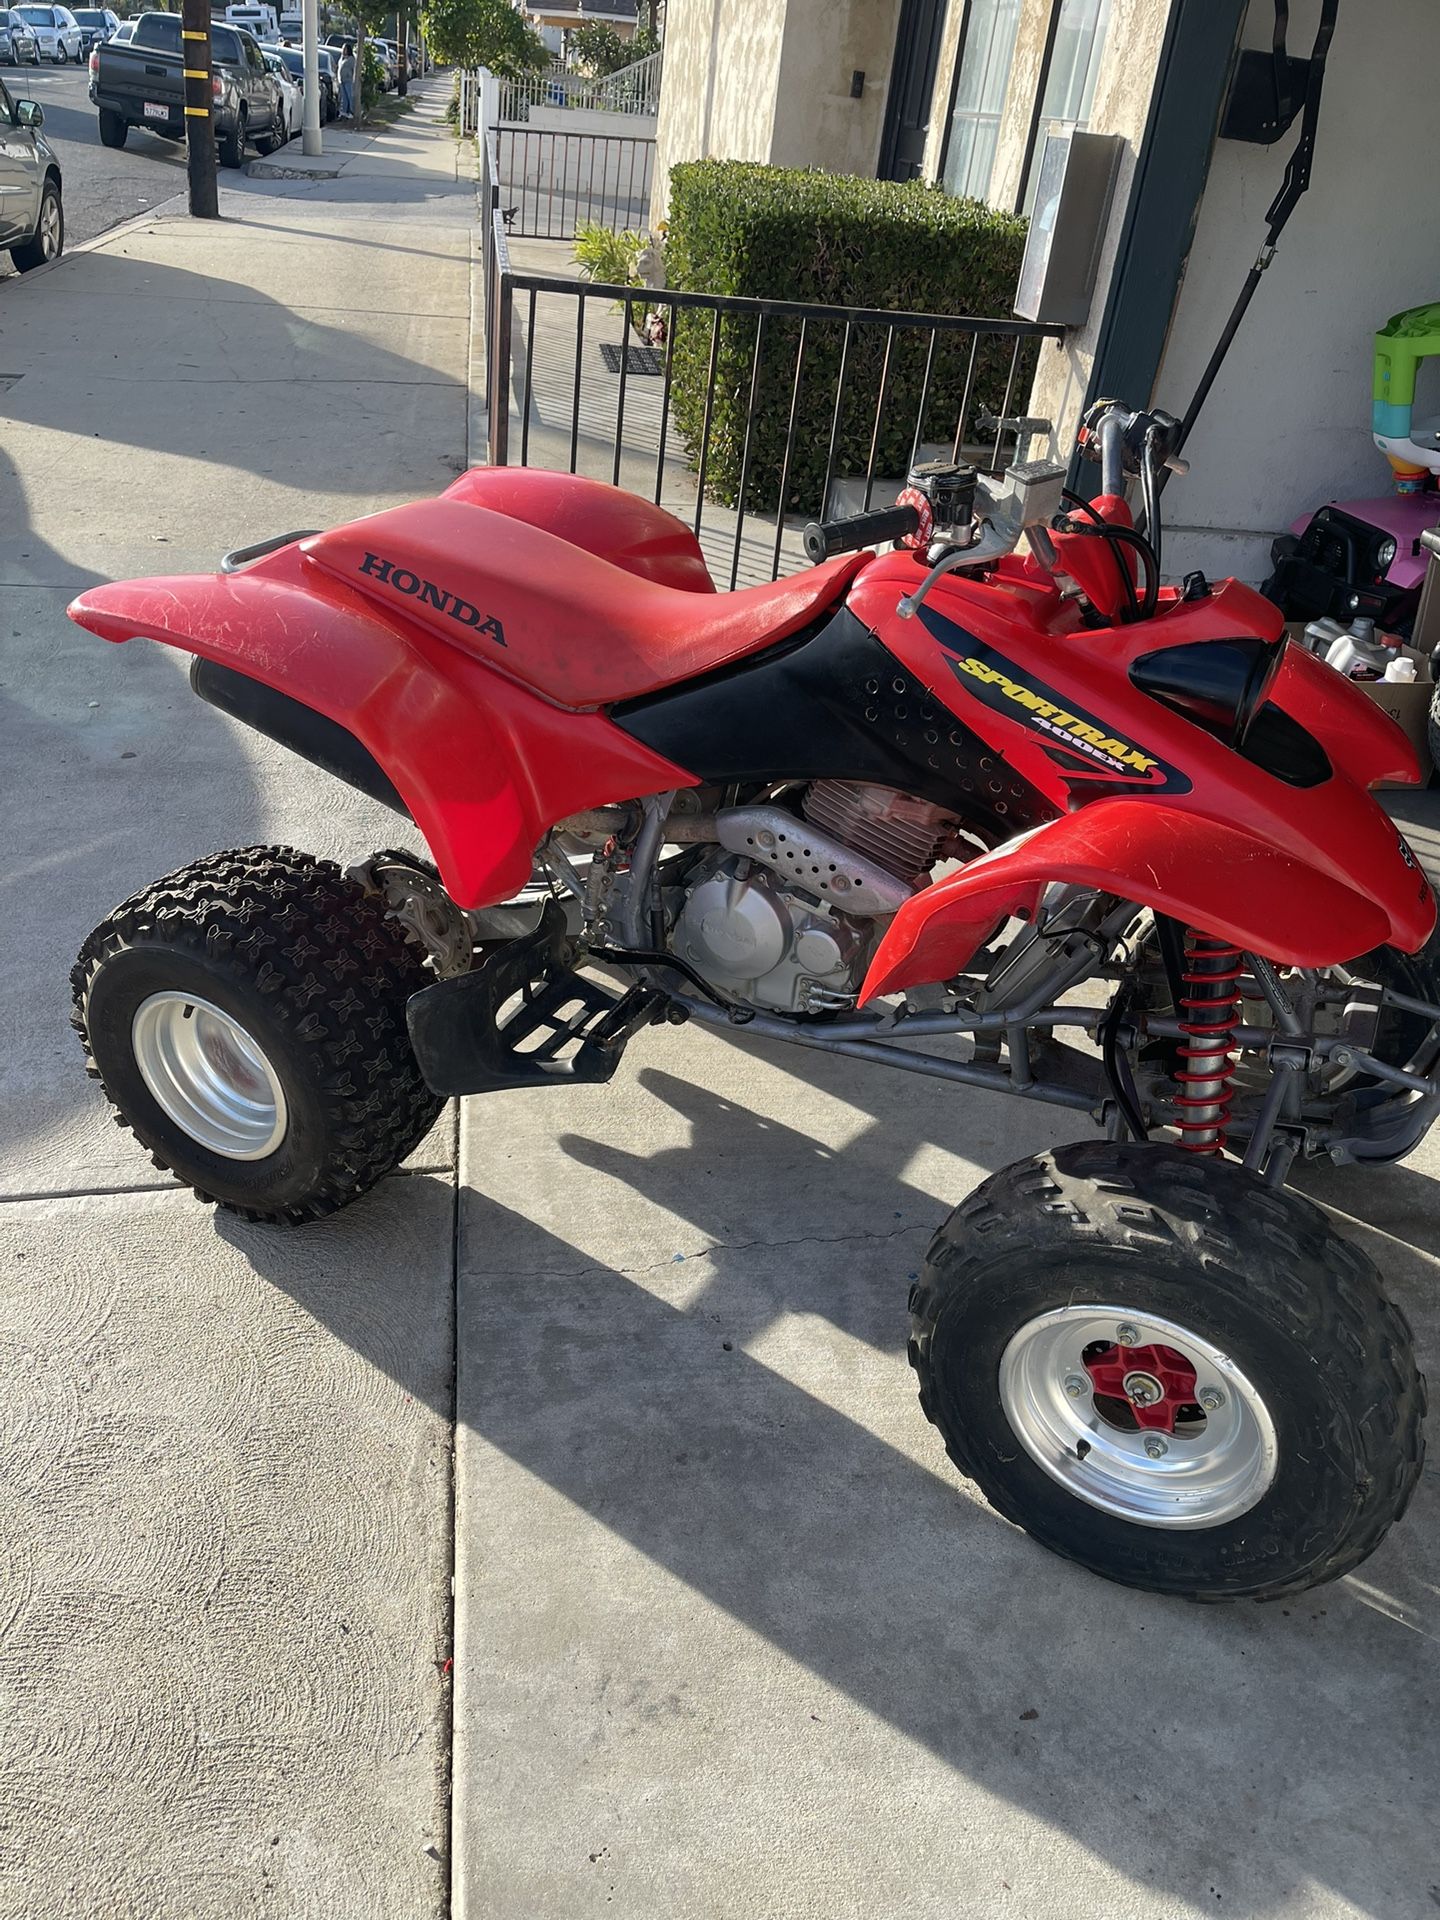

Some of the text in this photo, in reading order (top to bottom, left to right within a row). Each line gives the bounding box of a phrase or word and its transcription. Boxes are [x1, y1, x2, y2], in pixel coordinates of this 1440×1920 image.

[358, 552, 508, 648] HONDA
[958, 657, 1160, 772] SPORTRAX
[1030, 717, 1126, 772] 400EX
